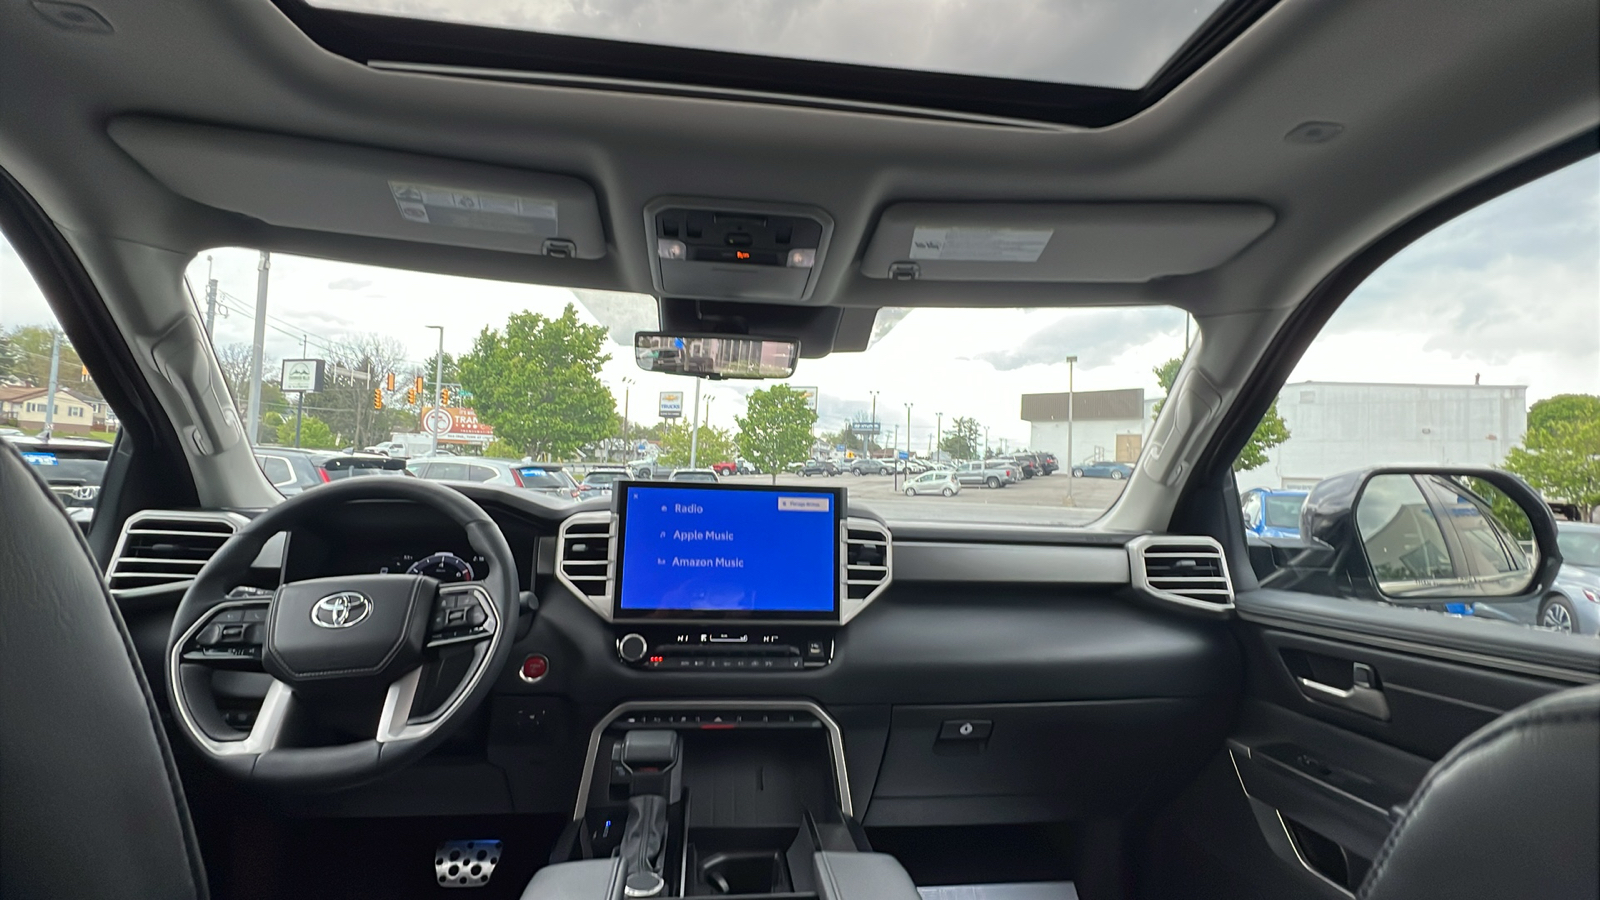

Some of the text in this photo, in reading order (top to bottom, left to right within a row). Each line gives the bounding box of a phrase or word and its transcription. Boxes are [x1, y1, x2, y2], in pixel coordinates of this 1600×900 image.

[675, 503, 704, 514] Radio
[673, 529, 734, 542] Apple Music
[672, 556, 744, 568] Amazon Music
